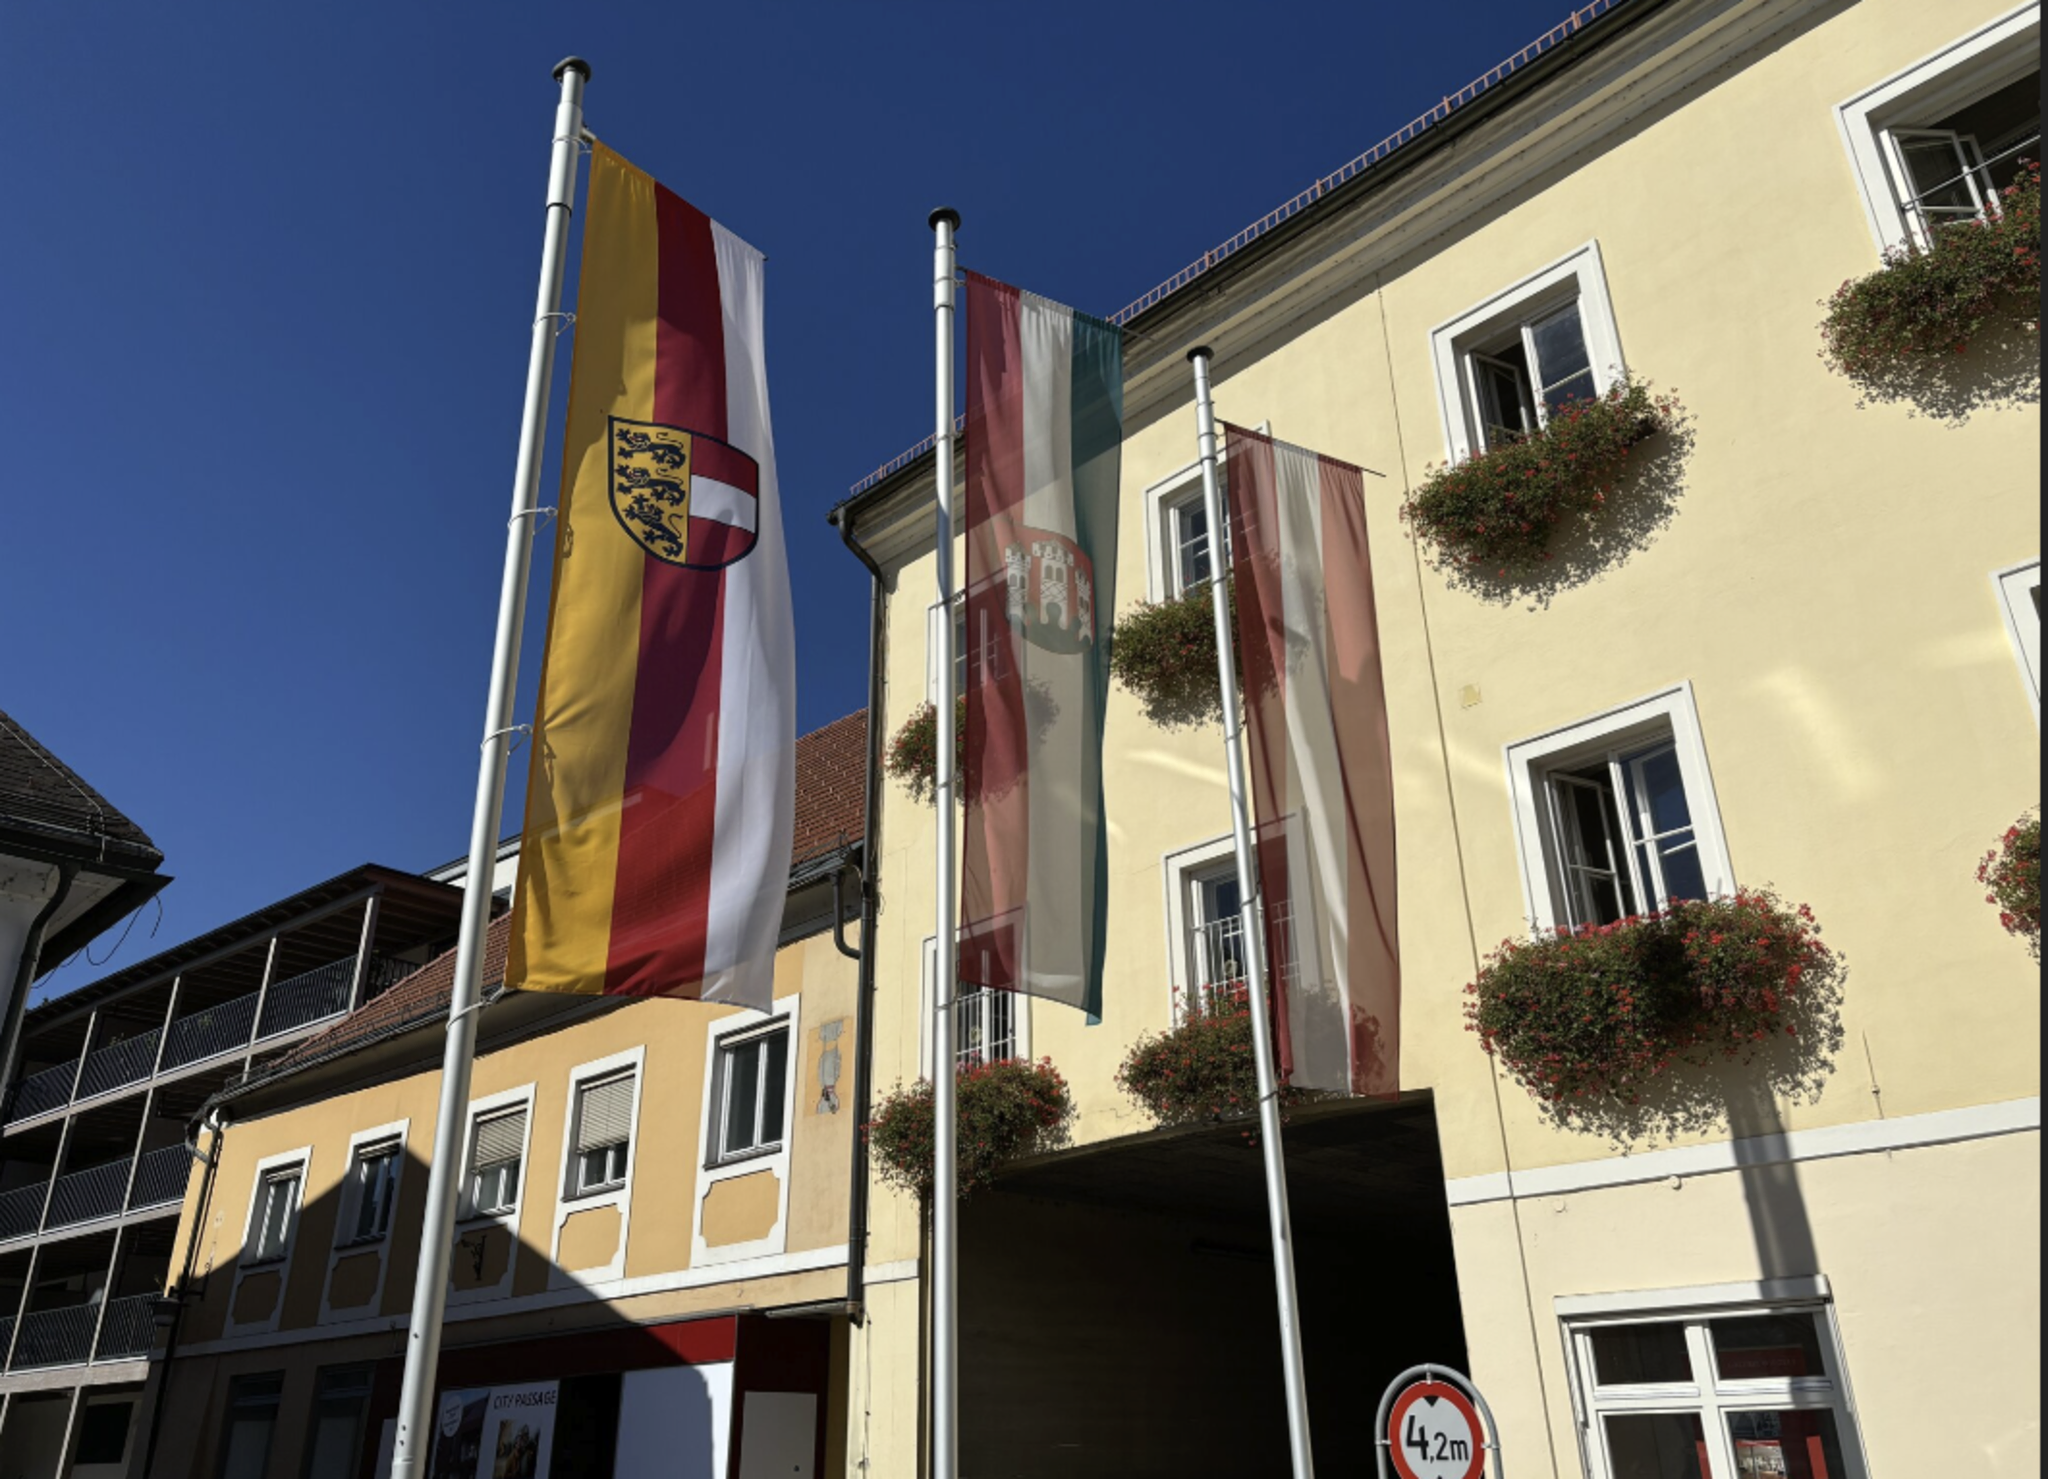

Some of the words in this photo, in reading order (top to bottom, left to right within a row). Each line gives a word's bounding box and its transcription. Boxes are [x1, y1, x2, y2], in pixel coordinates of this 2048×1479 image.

[494, 1394, 514, 1409] CITY
[515, 1390, 557, 1407] PASSAGE
[1406, 1415, 1469, 1463] 4,2m
